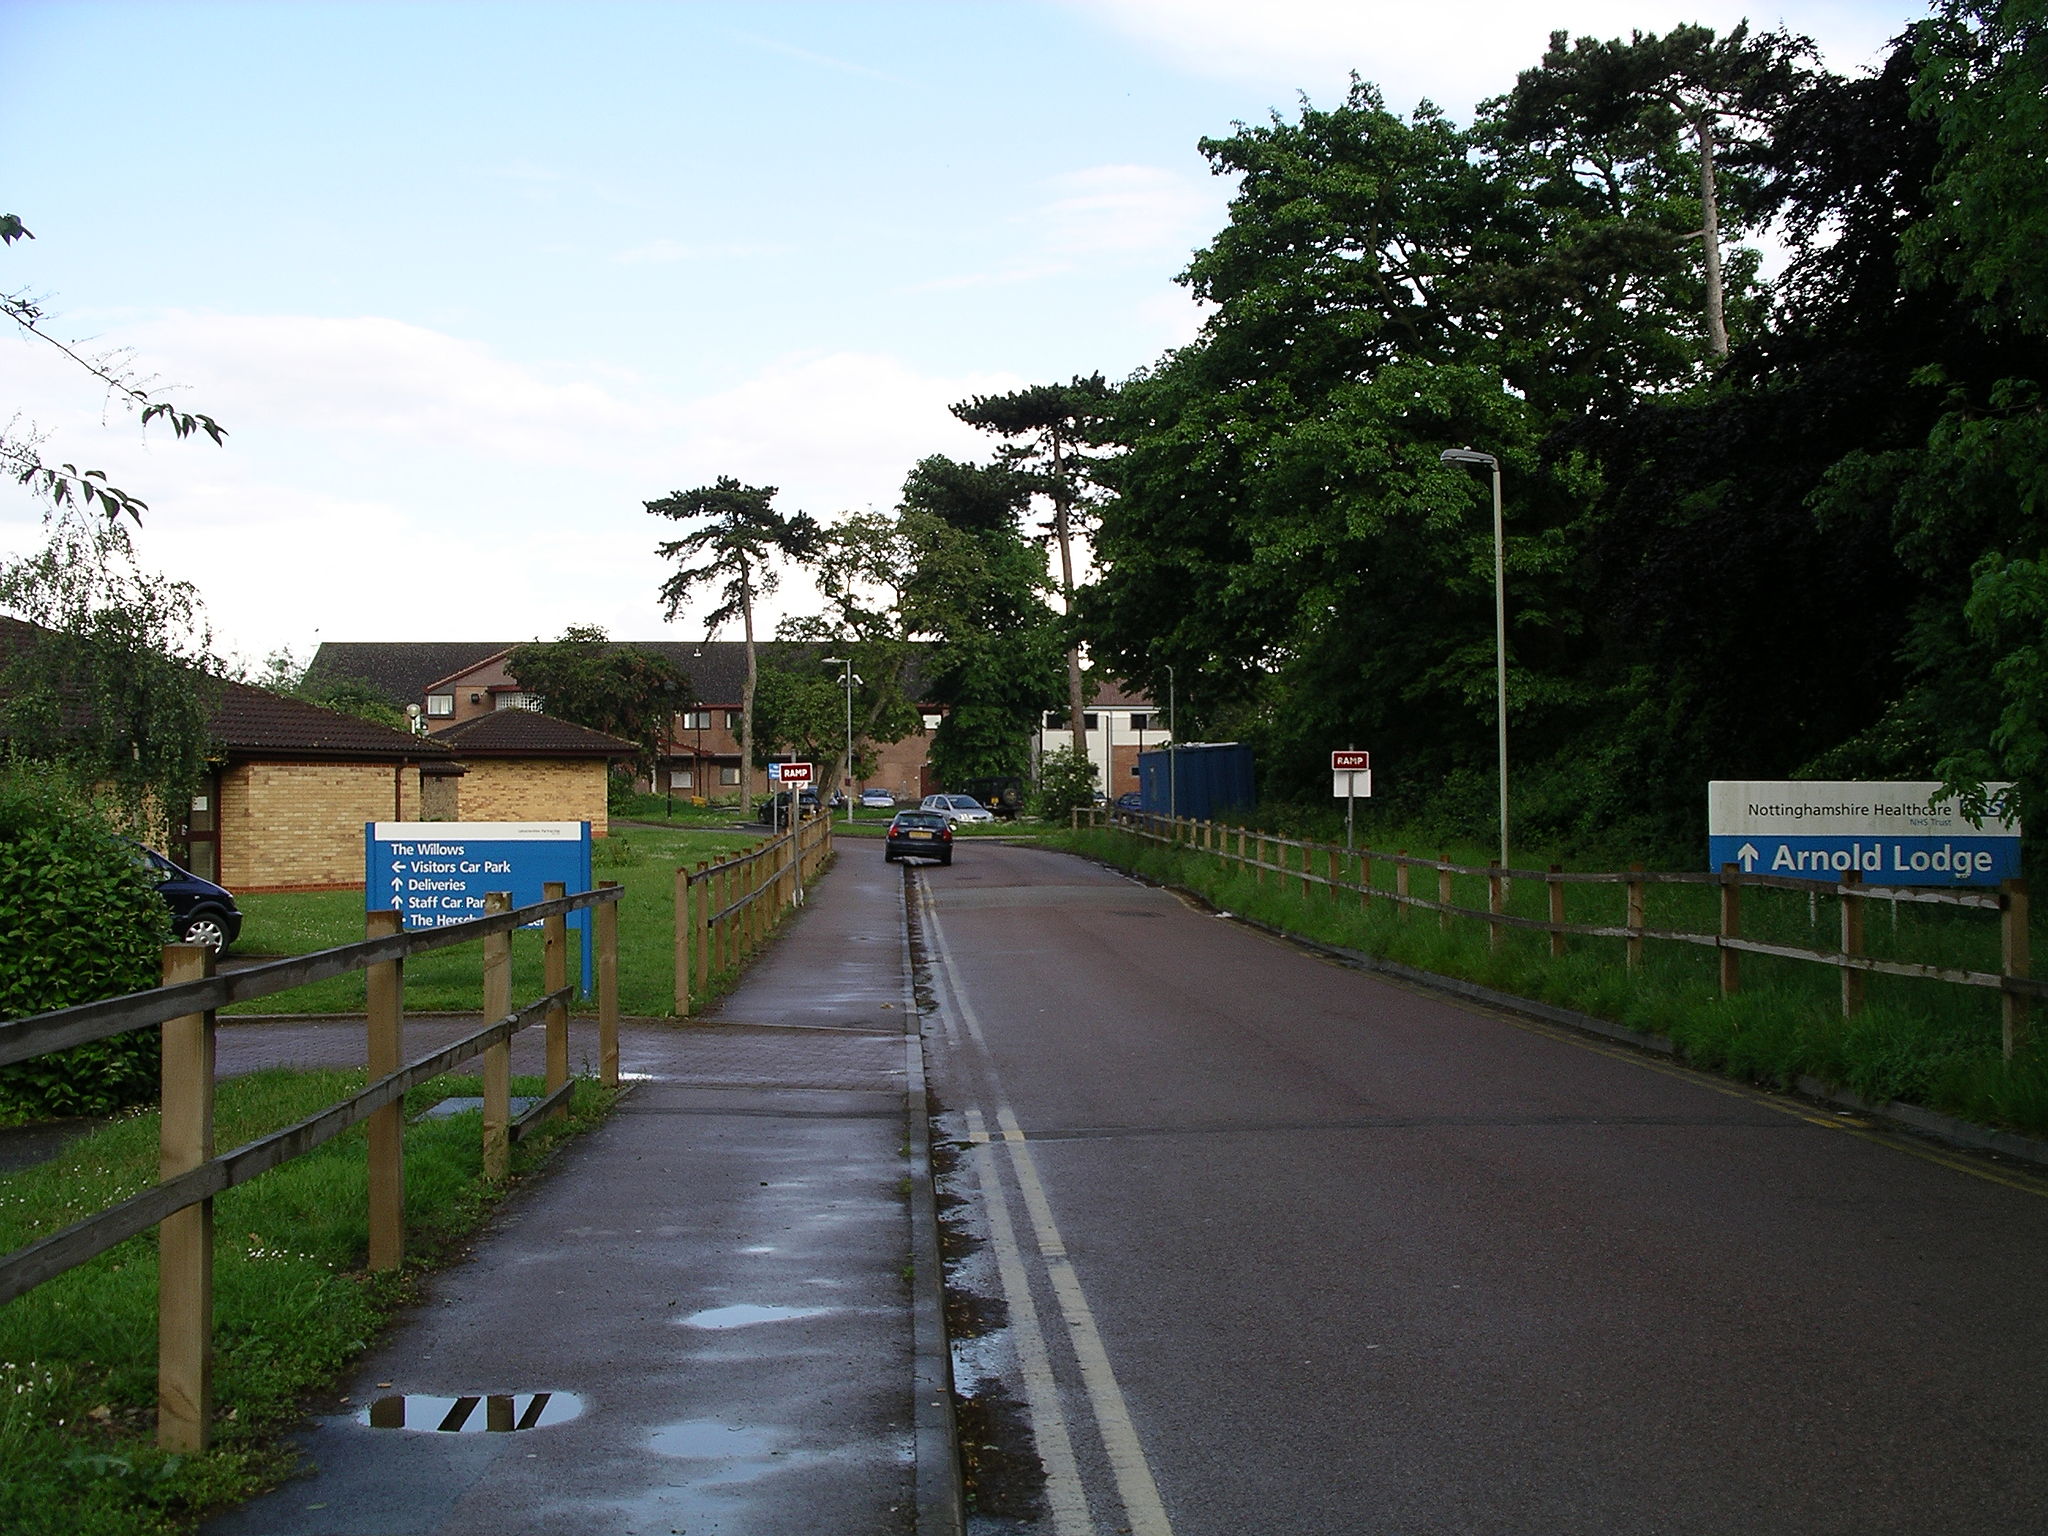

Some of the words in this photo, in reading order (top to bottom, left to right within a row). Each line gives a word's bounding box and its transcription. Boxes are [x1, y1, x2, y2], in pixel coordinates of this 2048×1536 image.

[1336, 756, 1364, 765] RAMP
[784, 768, 808, 778] RAMP
[1748, 803, 1869, 819] Nottinghamshire
[1874, 803, 1952, 816] Healthcare
[390, 843, 414, 856] The
[417, 843, 465, 856] Willows
[410, 861, 456, 873] Visitors
[460, 861, 481, 873] Car
[484, 861, 511, 873] Park
[1771, 843, 1881, 871] Arnold
[1893, 844, 1993, 878] Lodge
[408, 878, 466, 891] Deliveries
[408, 896, 438, 908] Staff
[441, 896, 463, 909] Car
[466, 896, 486, 909] Par
[410, 913, 433, 926] The
